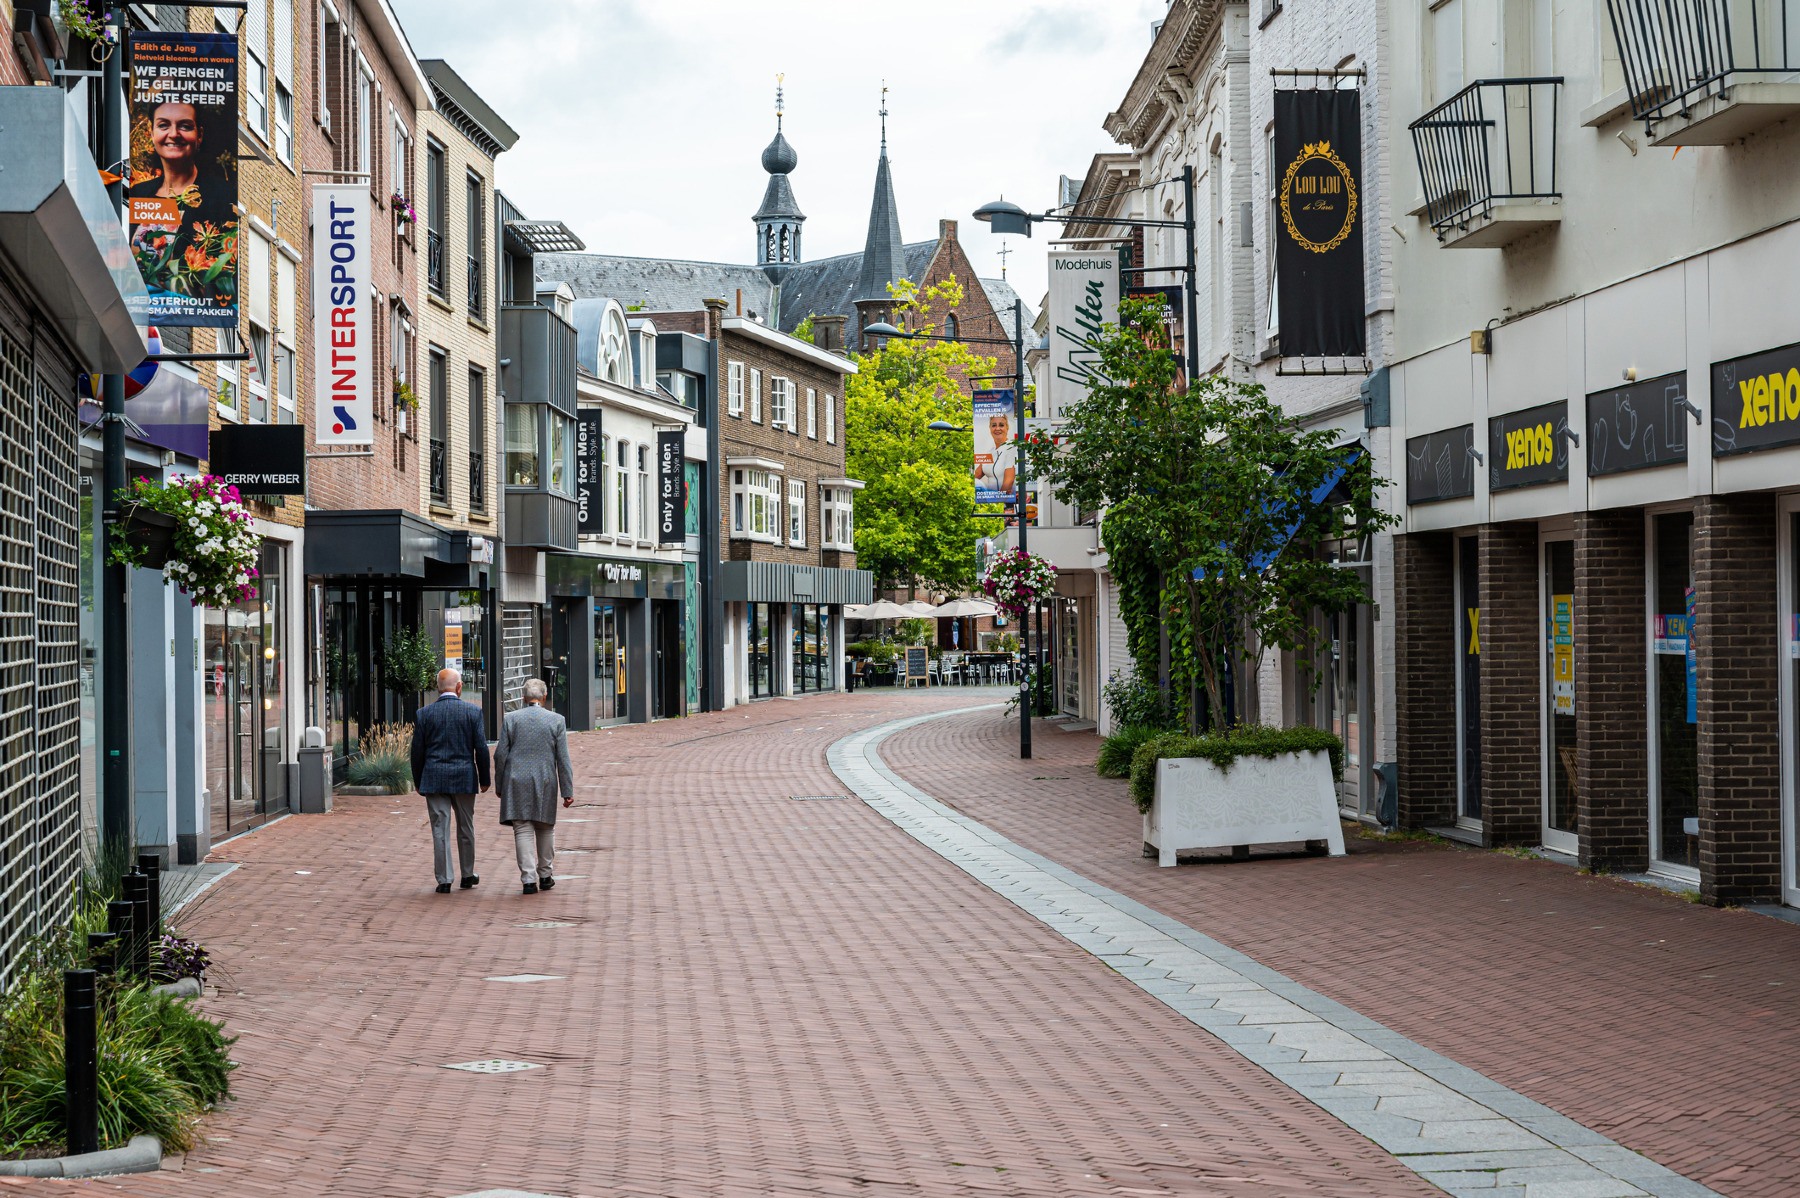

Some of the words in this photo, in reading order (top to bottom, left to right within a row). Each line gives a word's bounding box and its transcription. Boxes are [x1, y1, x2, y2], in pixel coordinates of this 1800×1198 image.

[134, 43, 158, 52] Edith
[160, 44, 171, 52] de
[174, 44, 197, 54] Jong
[134, 53, 165, 61] Rietveld
[134, 65, 157, 77] WE
[160, 66, 224, 79] BRENGEN
[134, 79, 149, 90] JE
[152, 80, 197, 91] GELIJK
[200, 81, 215, 92] IN
[216, 82, 234, 92] DE
[134, 92, 180, 104] JUISTE
[182, 93, 226, 105] SFEER
[1295, 175, 1316, 195] LOU
[1319, 175, 1341, 195] LOU
[133, 201, 162, 211] SHOP
[1302, 203, 1311, 211] de
[1312, 200, 1334, 211] Paris
[133, 211, 176, 221] LOKAAL
[1055, 258, 1112, 271] Modehuis
[148, 296, 214, 307] STERHOUT
[329, 200, 357, 401] INTERSPORT
[148, 307, 182, 316] SMAAK
[183, 307, 195, 316] TE
[196, 308, 234, 317] PAKKEN
[1056, 279, 1113, 388] Welten
[1739, 367, 1800, 430] xeno
[589, 420, 597, 435] Life.
[577, 422, 588, 456] Men
[589, 437, 598, 456] Style.
[1506, 421, 1553, 471] xenos
[662, 443, 672, 474] Men
[673, 456, 681, 474] Style.
[224, 473, 260, 484] GERRY
[262, 473, 300, 484] WEBER
[577, 460, 588, 484] for
[662, 477, 672, 499] for
[577, 487, 590, 523] Only
[662, 500, 674, 534] Only
[607, 565, 620, 584] Only
[618, 564, 629, 581] for
[629, 566, 642, 581] Men
